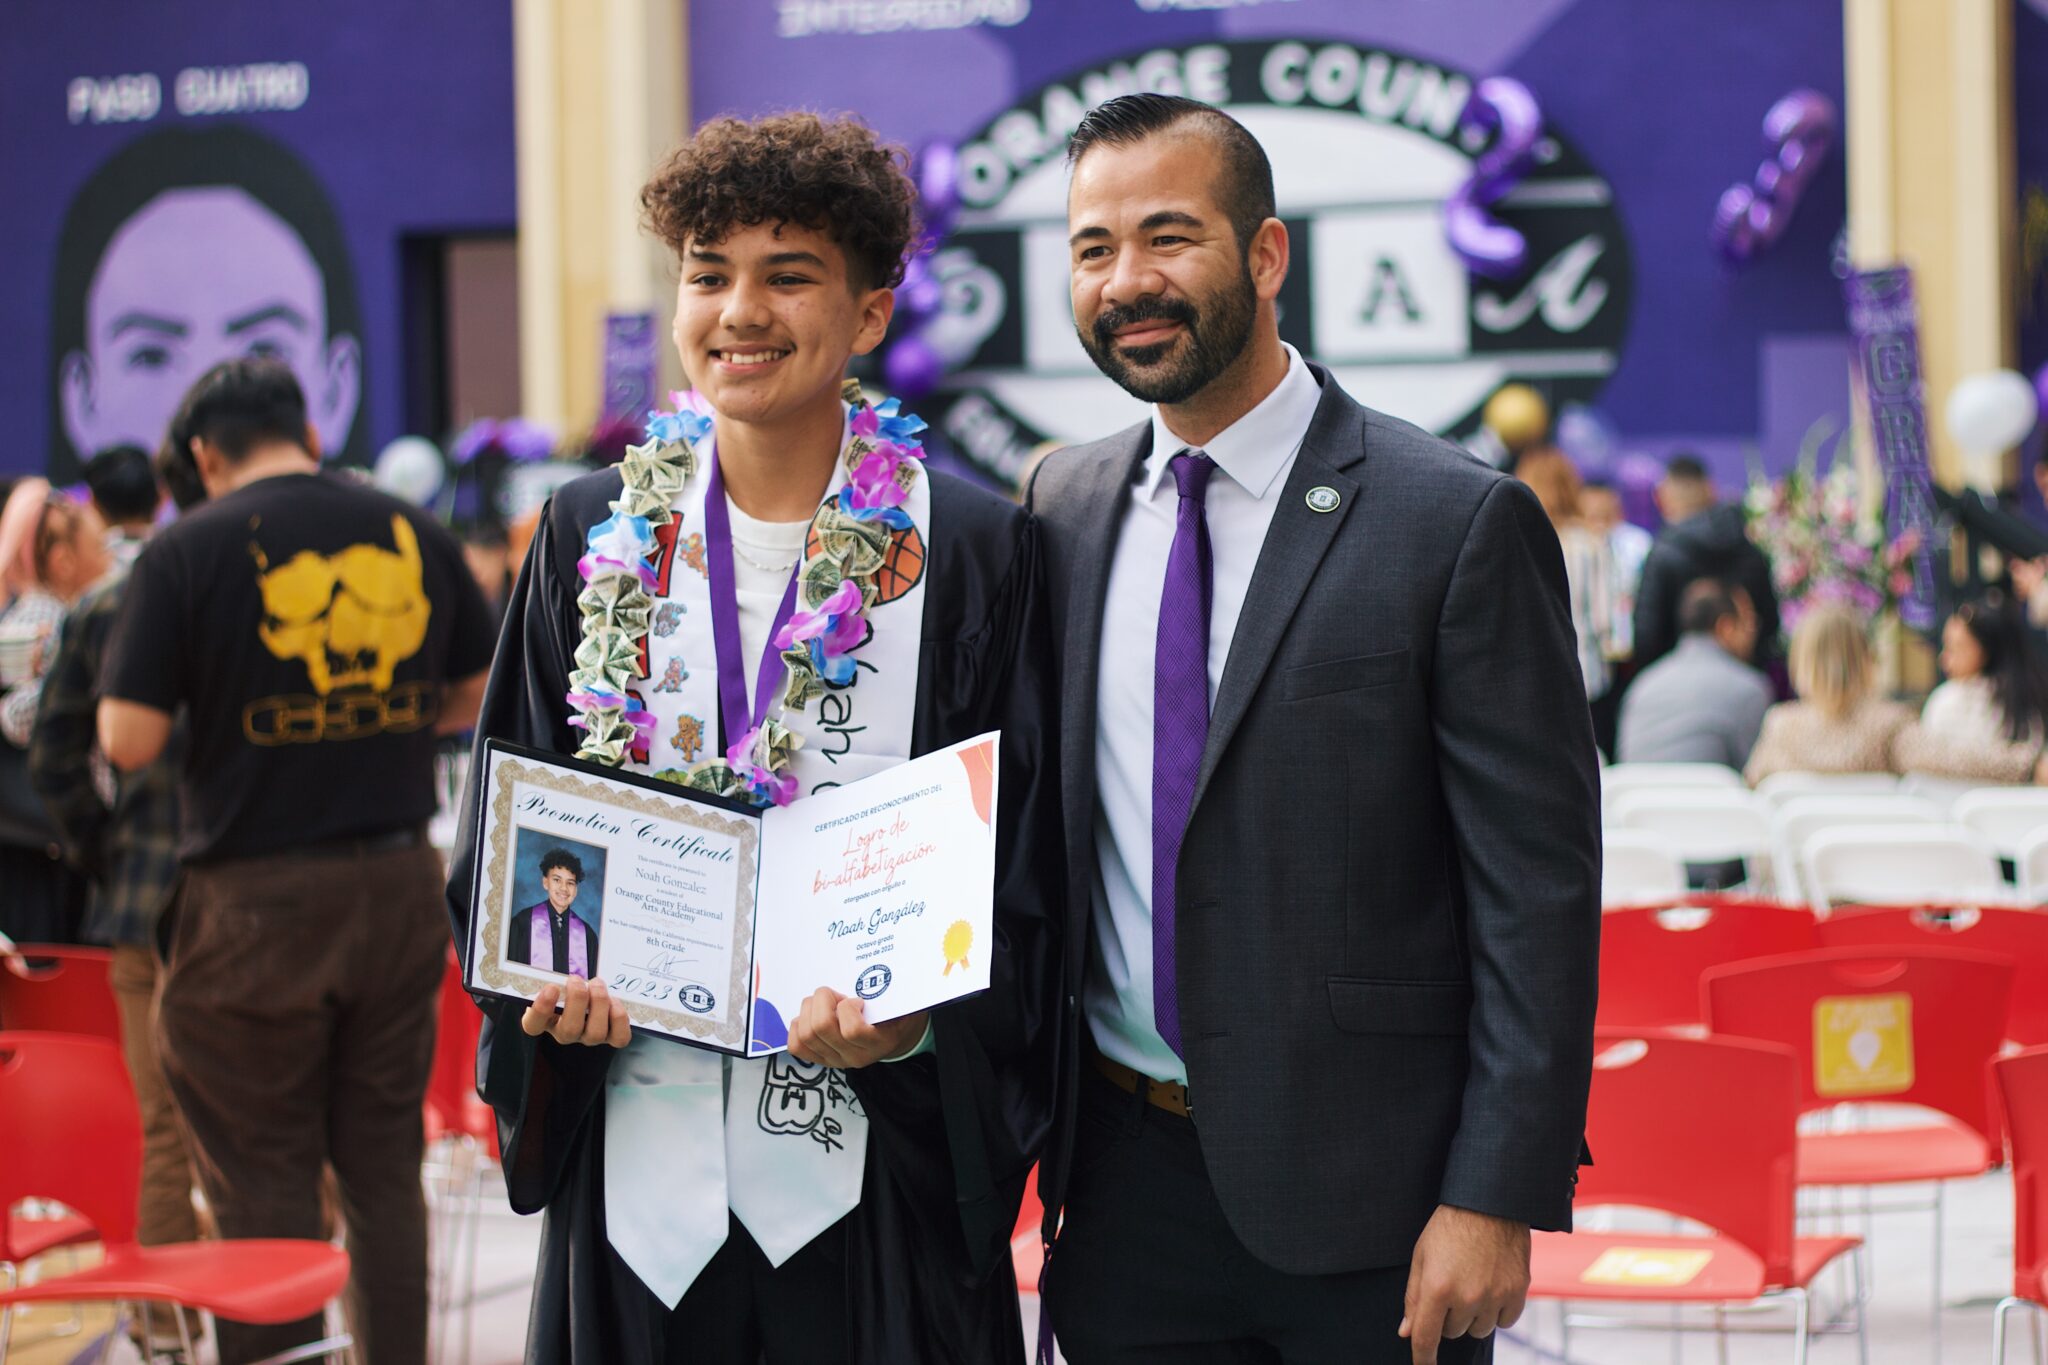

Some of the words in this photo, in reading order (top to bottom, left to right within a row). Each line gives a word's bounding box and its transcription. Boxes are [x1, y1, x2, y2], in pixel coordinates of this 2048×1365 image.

[67, 72, 161, 125] PASO
[175, 61, 309, 116] CUATRO
[958, 44, 1230, 207] ORANGE
[815, 813, 860, 832] CERTIFICADO
[860, 809, 869, 819] DE
[870, 788, 929, 815] RECONOCIMIENTO
[930, 784, 942, 794] DEL
[517, 791, 622, 834] Promotion
[631, 818, 735, 862] Certificate
[842, 827, 886, 856] Logro
[890, 810, 909, 838] de
[635, 867, 661, 882] Noah
[663, 874, 707, 894] Gonzalez
[843, 891, 870, 904] otorgado
[871, 888, 881, 896] con
[882, 881, 901, 892] orgullo
[615, 887, 644, 902] Orange
[646, 894, 675, 910] County
[677, 902, 723, 920] Educational
[641, 902, 659, 913] Arts
[660, 907, 696, 924] Academy
[828, 917, 865, 940] Noah
[868, 900, 926, 935] González
[646, 936, 659, 947] 8th
[661, 940, 686, 953] Grade
[856, 940, 877, 950] Octavo
[877, 934, 894, 946] grado
[856, 951, 872, 961] mayo
[881, 943, 894, 954] 2023
[609, 973, 673, 1000] 2023
